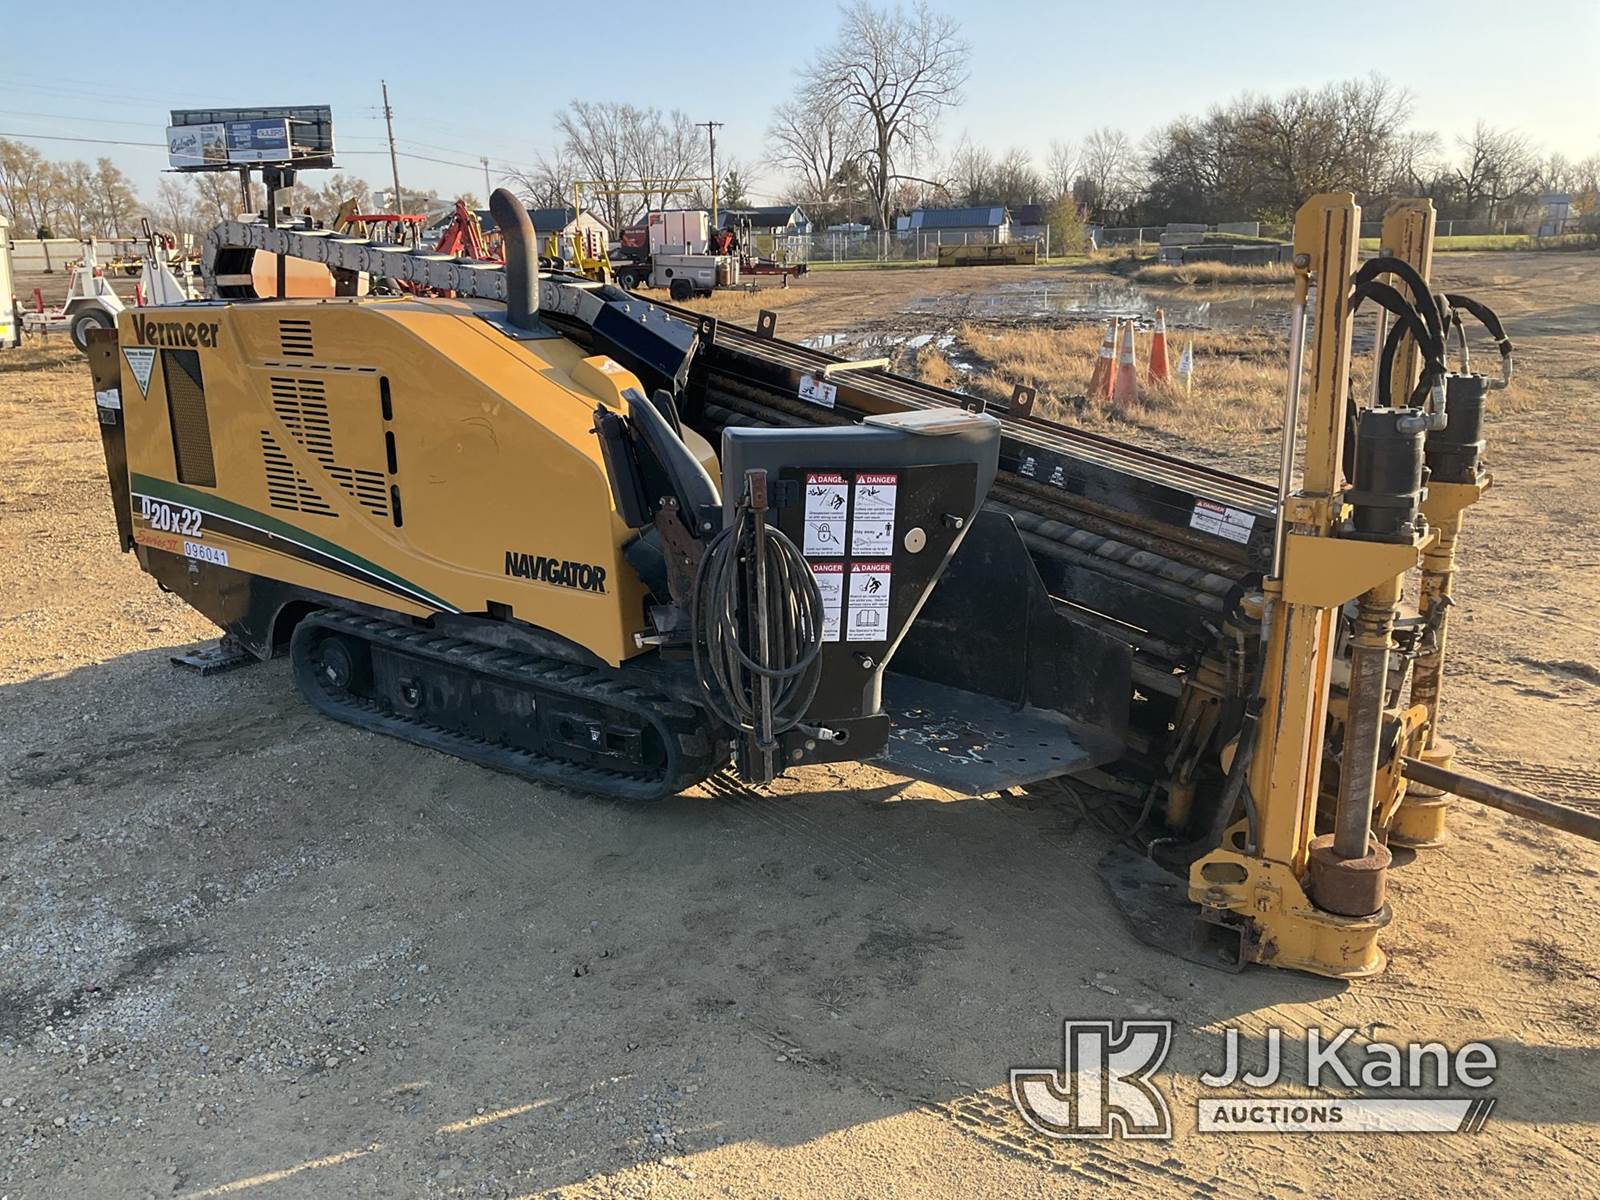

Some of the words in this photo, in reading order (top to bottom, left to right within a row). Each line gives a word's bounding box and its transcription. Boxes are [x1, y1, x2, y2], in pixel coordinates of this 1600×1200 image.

[131, 313, 218, 347] Vermeer
[867, 476, 896, 484] DANGER
[184, 542, 225, 564] 096041
[505, 551, 606, 592] NAVIGATOR
[861, 563, 890, 571] DANGER
